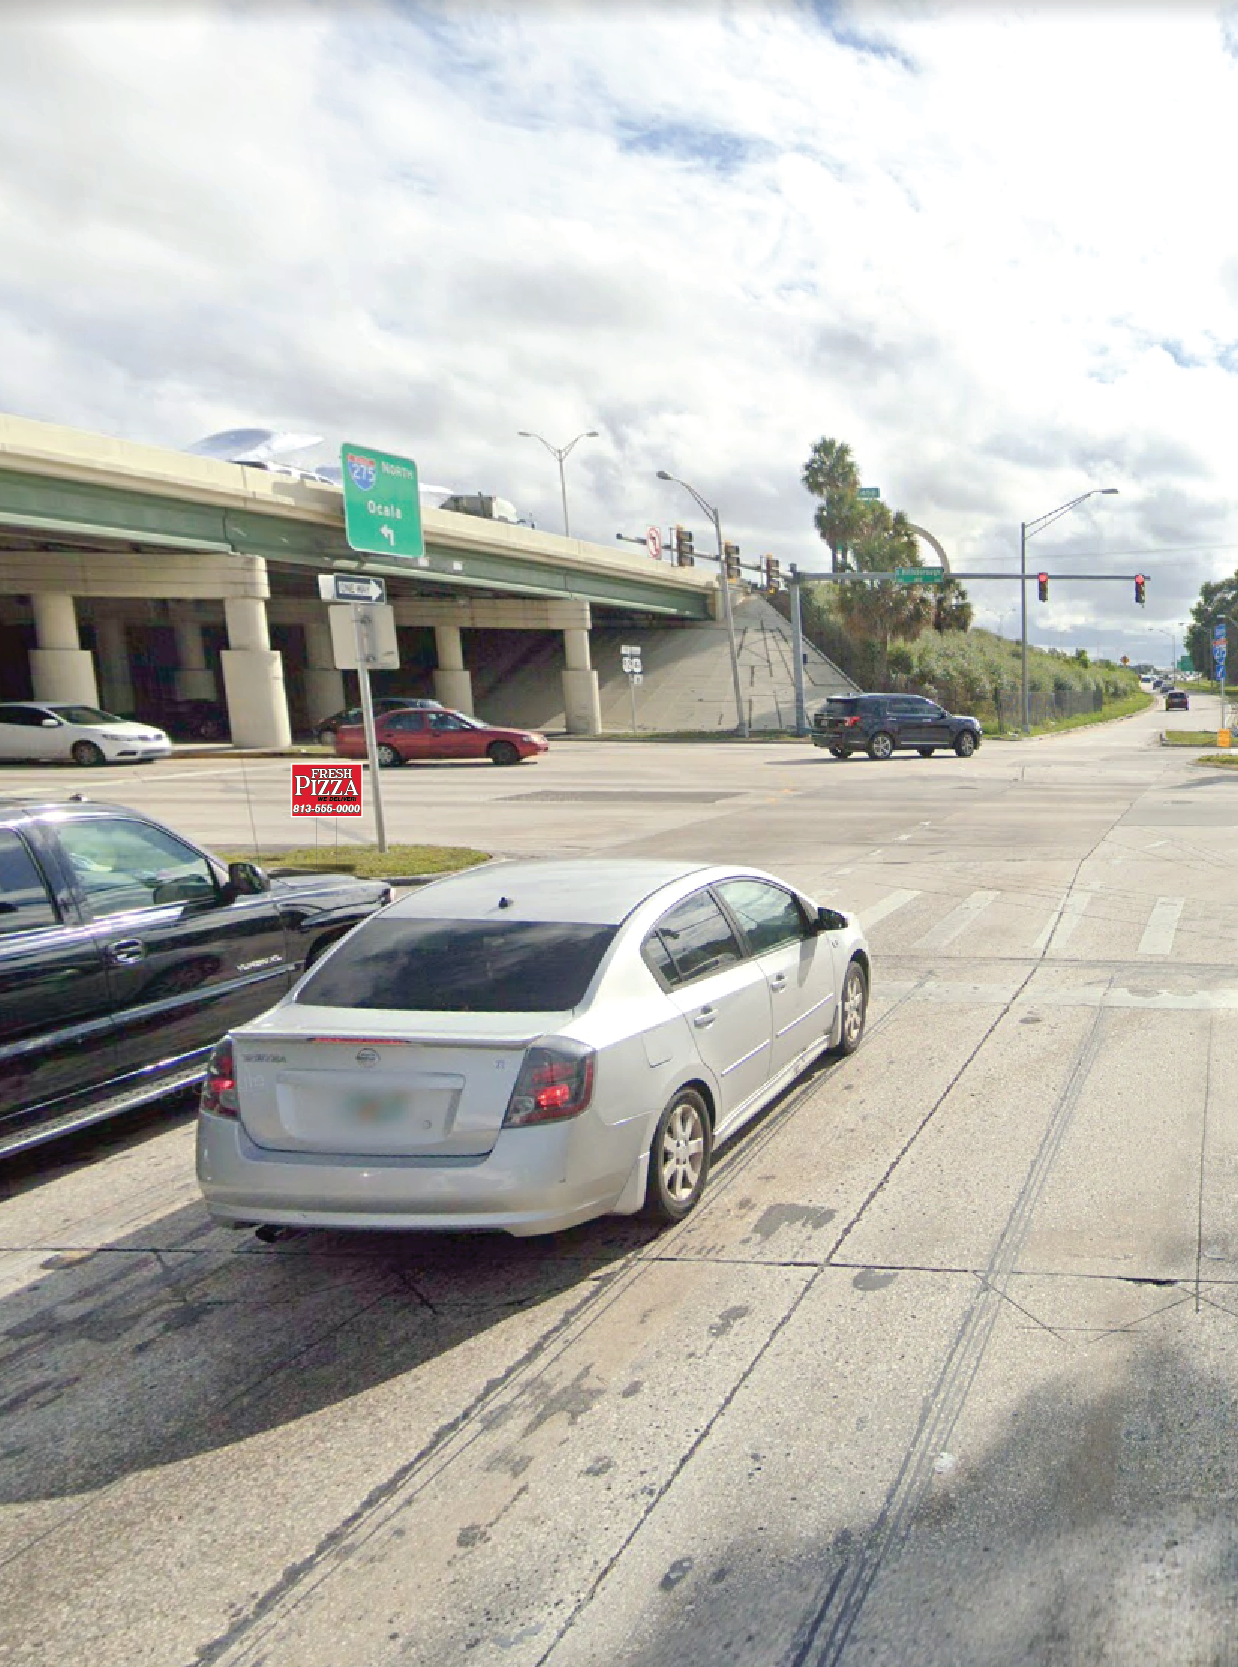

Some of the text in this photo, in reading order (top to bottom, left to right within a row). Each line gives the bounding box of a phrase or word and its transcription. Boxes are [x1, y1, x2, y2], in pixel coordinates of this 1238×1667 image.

[353, 461, 414, 481] 275 NORTH
[367, 500, 402, 519] Ocala
[311, 768, 353, 779] FRESH
[294, 775, 359, 796] PIZZA
[293, 804, 361, 813] 813-555-0000
